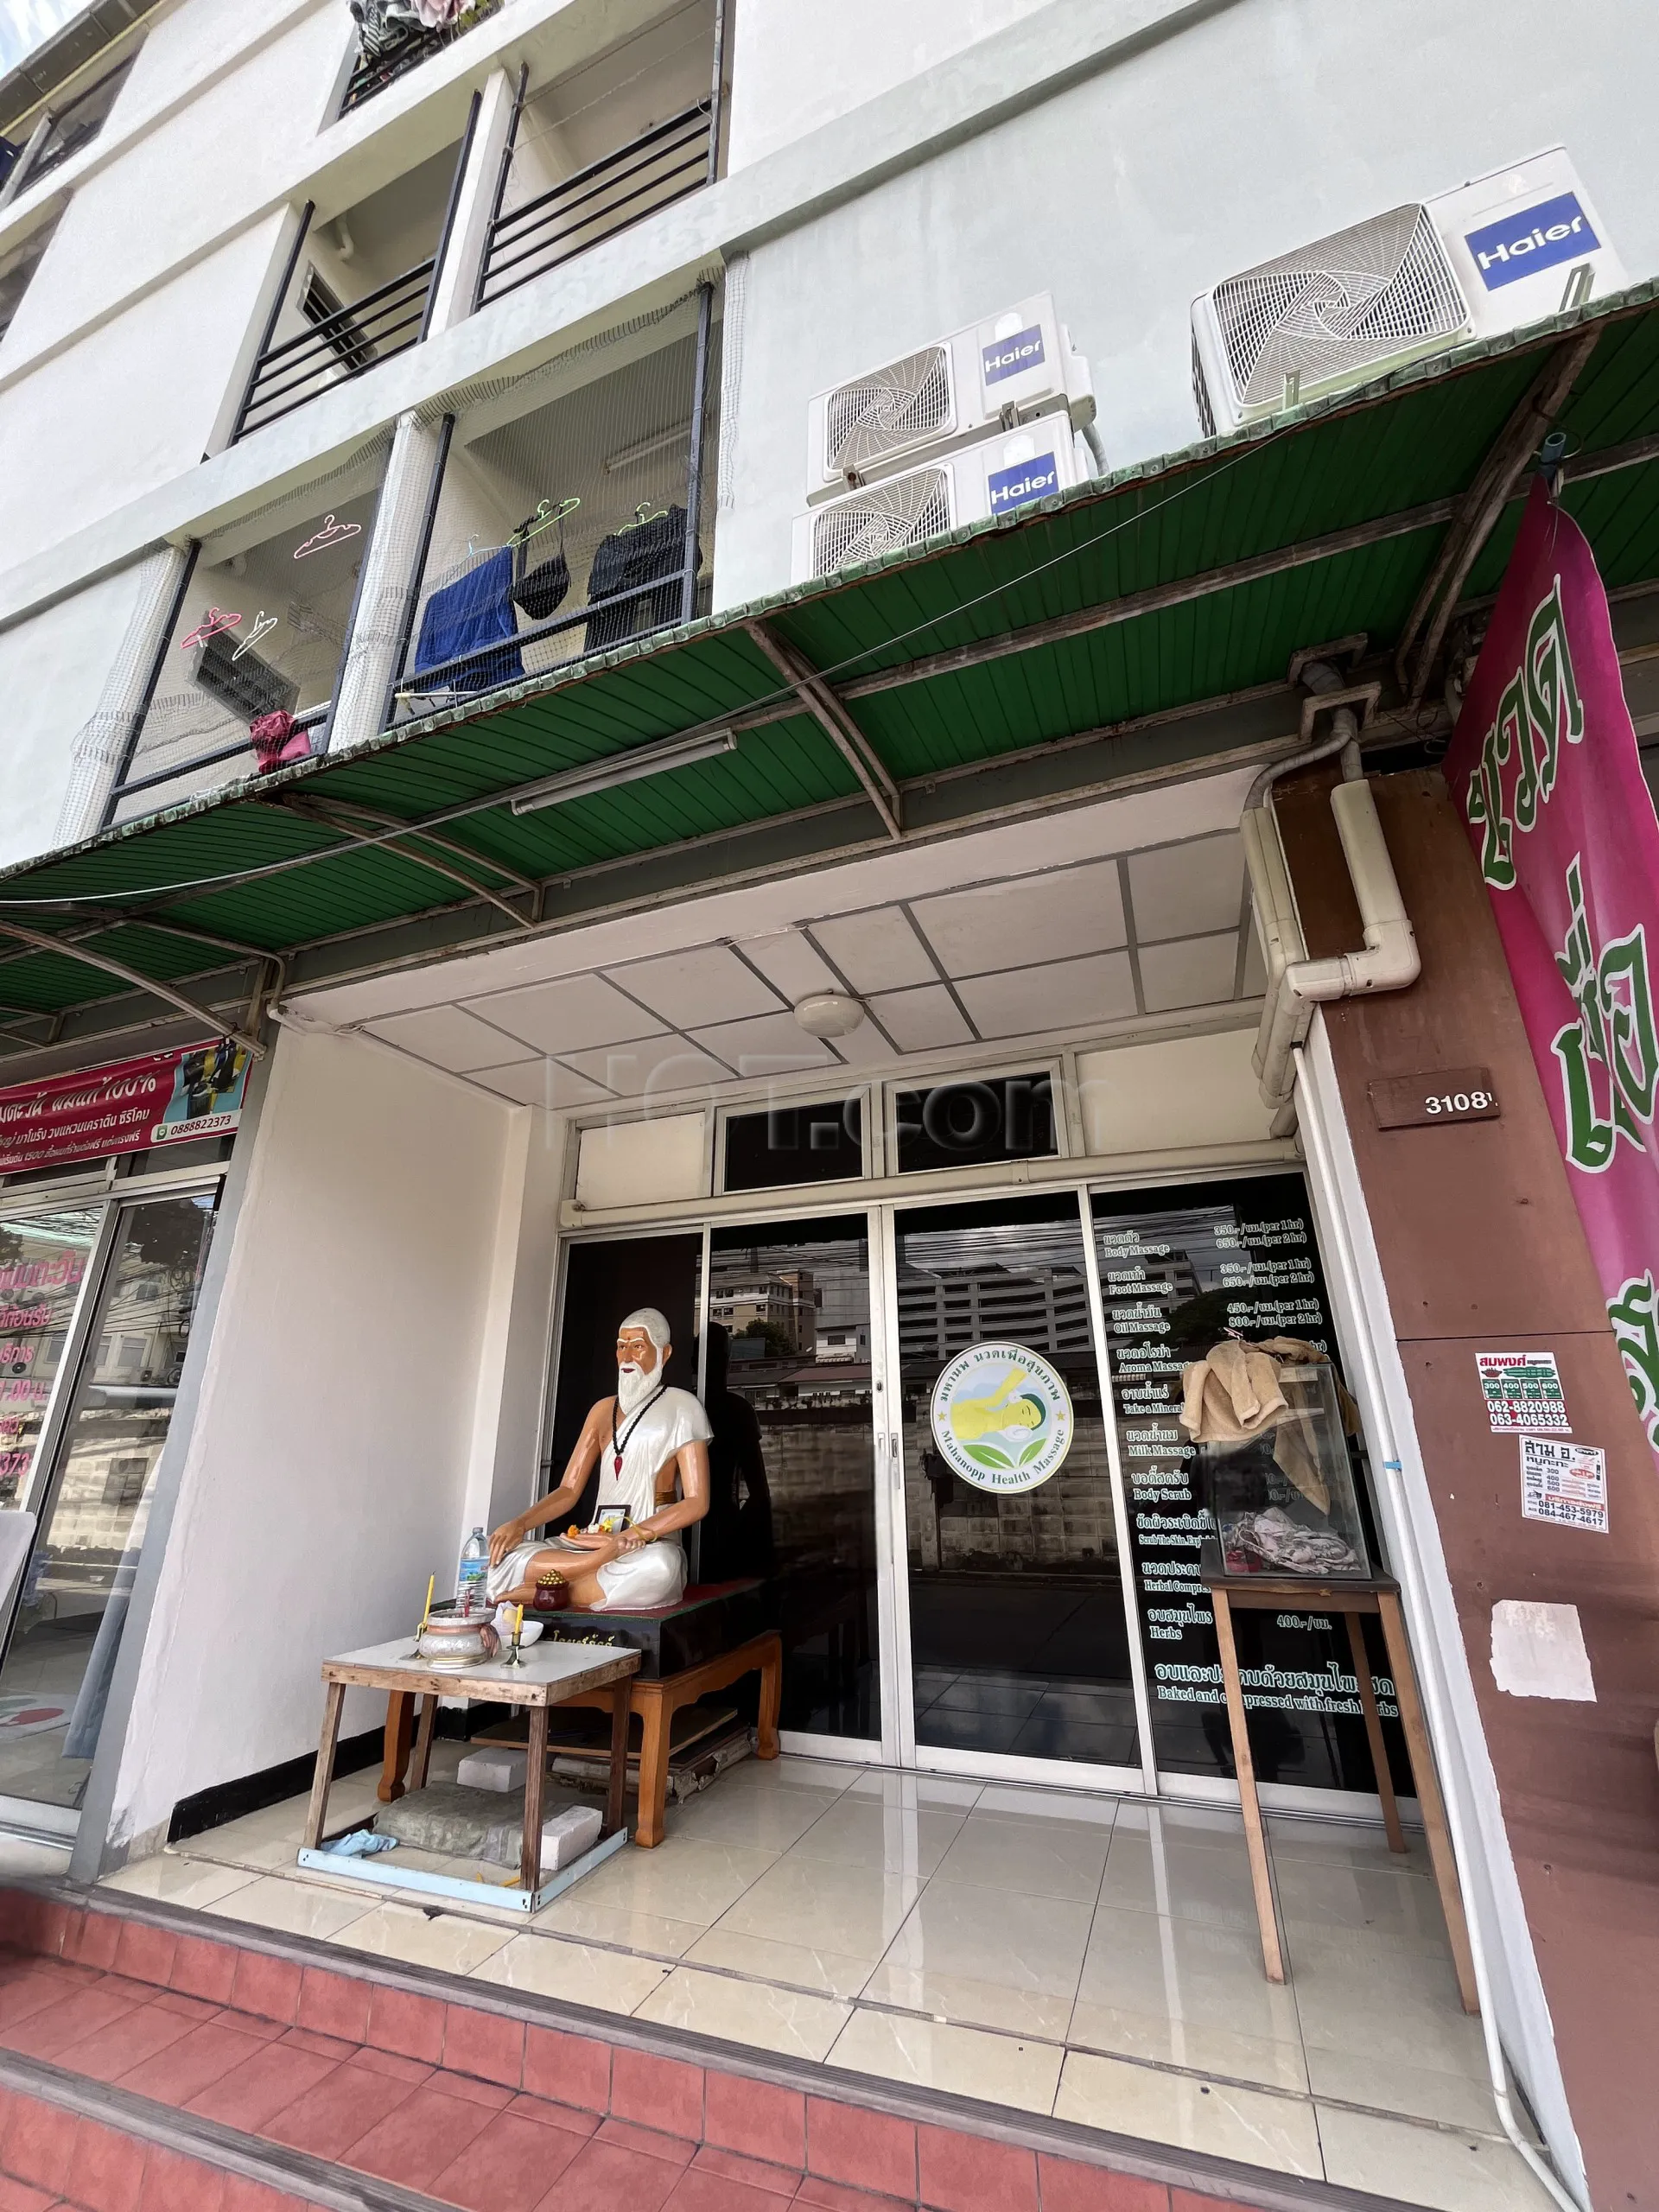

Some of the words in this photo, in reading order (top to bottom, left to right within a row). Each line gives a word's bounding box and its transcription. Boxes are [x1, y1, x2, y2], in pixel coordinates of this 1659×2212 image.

[1477, 215, 1582, 270] Haier
[984, 340, 1041, 373] Haier
[990, 471, 1055, 505] Haier
[170, 1115, 232, 1135] 0888822373
[1103, 1230, 1140, 1244] นวดตัว
[1105, 1246, 1128, 1258] Body
[1129, 1244, 1170, 1256] Massage
[1108, 1266, 1146, 1281] นวดเท้า
[1109, 1284, 1133, 1295] Foot
[1132, 1282, 1173, 1294] Massage
[1112, 1301, 1162, 1319] นวดน้ำมัน
[1114, 1323, 1129, 1333] Oil
[1129, 1322, 1171, 1334] Massage
[1116, 1341, 1171, 1359] นวดอโรม่า
[1119, 1363, 1152, 1373] Aroma
[1479, 1354, 1527, 1367] สมพงศ์
[1122, 1381, 1169, 1399] อาบน้ำแร่
[1123, 1403, 1146, 1414] Take
[1487, 1400, 1566, 1413] 062-8820988
[1490, 1413, 1569, 1426] 063-4065332
[1126, 1422, 1178, 1441] นวดน้ำนม
[941, 1430, 986, 1481] Mahanopp
[992, 1471, 1031, 1484] Health
[1033, 1429, 1065, 1475] Massage
[1128, 1445, 1153, 1456] Milk
[1152, 1446, 1196, 1459] Massage
[1133, 1488, 1160, 1503] Body
[1160, 1488, 1192, 1500] Scrub
[1538, 1500, 1604, 1518] 081-453-5979
[1538, 1508, 1604, 1526] 084-467-4617
[1139, 1534, 1159, 1545] Scrub
[1158, 1534, 1171, 1545] The
[1144, 1580, 1173, 1591] Herbal
[1147, 1603, 1213, 1627] อบสมุนไพร
[1149, 1625, 1182, 1640] Herbs
[1157, 1686, 1195, 1701] Baked
[1195, 1689, 1220, 1703] and
[1219, 1694, 1294, 1709] cpressed
[1294, 1695, 1325, 1711] with
[1324, 1697, 1360, 1713] fresh
